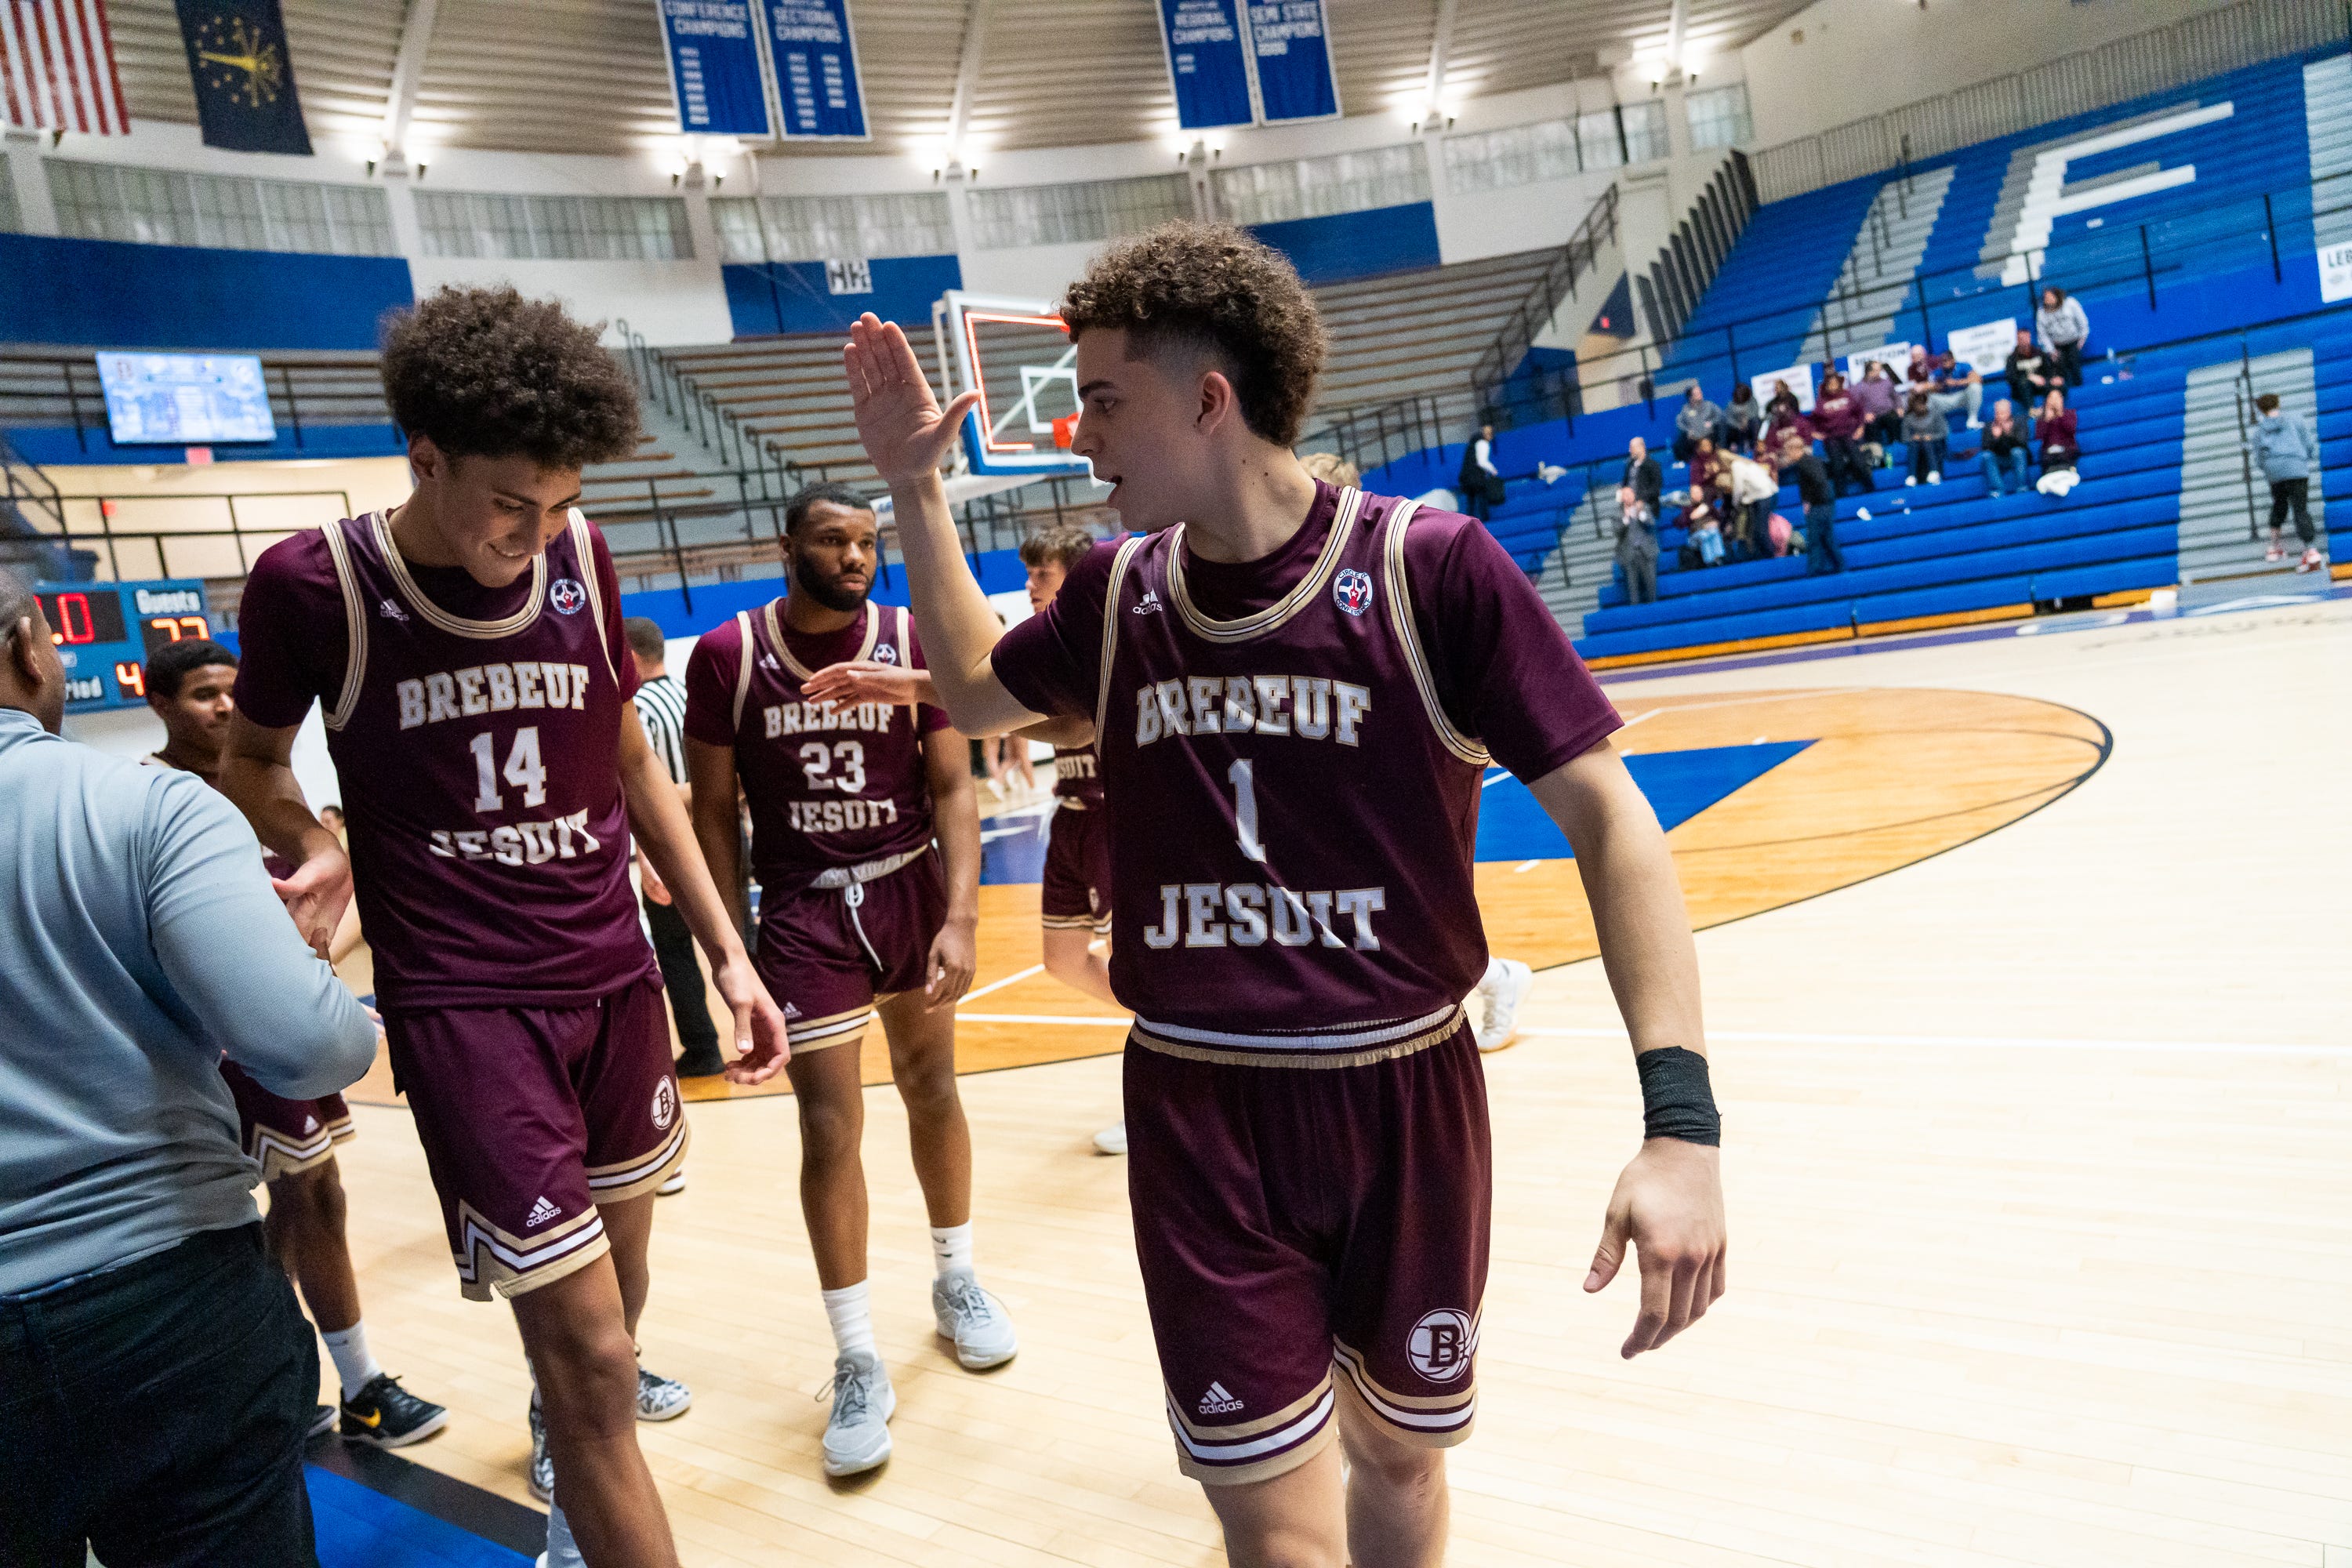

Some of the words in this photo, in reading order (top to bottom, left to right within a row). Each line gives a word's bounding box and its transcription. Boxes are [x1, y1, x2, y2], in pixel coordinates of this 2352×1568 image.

[116, 662, 144, 696] 4
[397, 662, 589, 730] BREBEUF
[1136, 675, 1371, 749] BREBEUF
[470, 726, 546, 813] 14
[800, 740, 866, 793] 23
[1055, 753, 1096, 779] SUIT
[429, 808, 601, 866] JESUIT
[1228, 758, 1267, 864] 1
[1144, 882, 1385, 951] JESUIT
[526, 1205, 562, 1227] adidas
[1428, 1324, 1460, 1367] B
[1199, 1398, 1244, 1414] adidas
